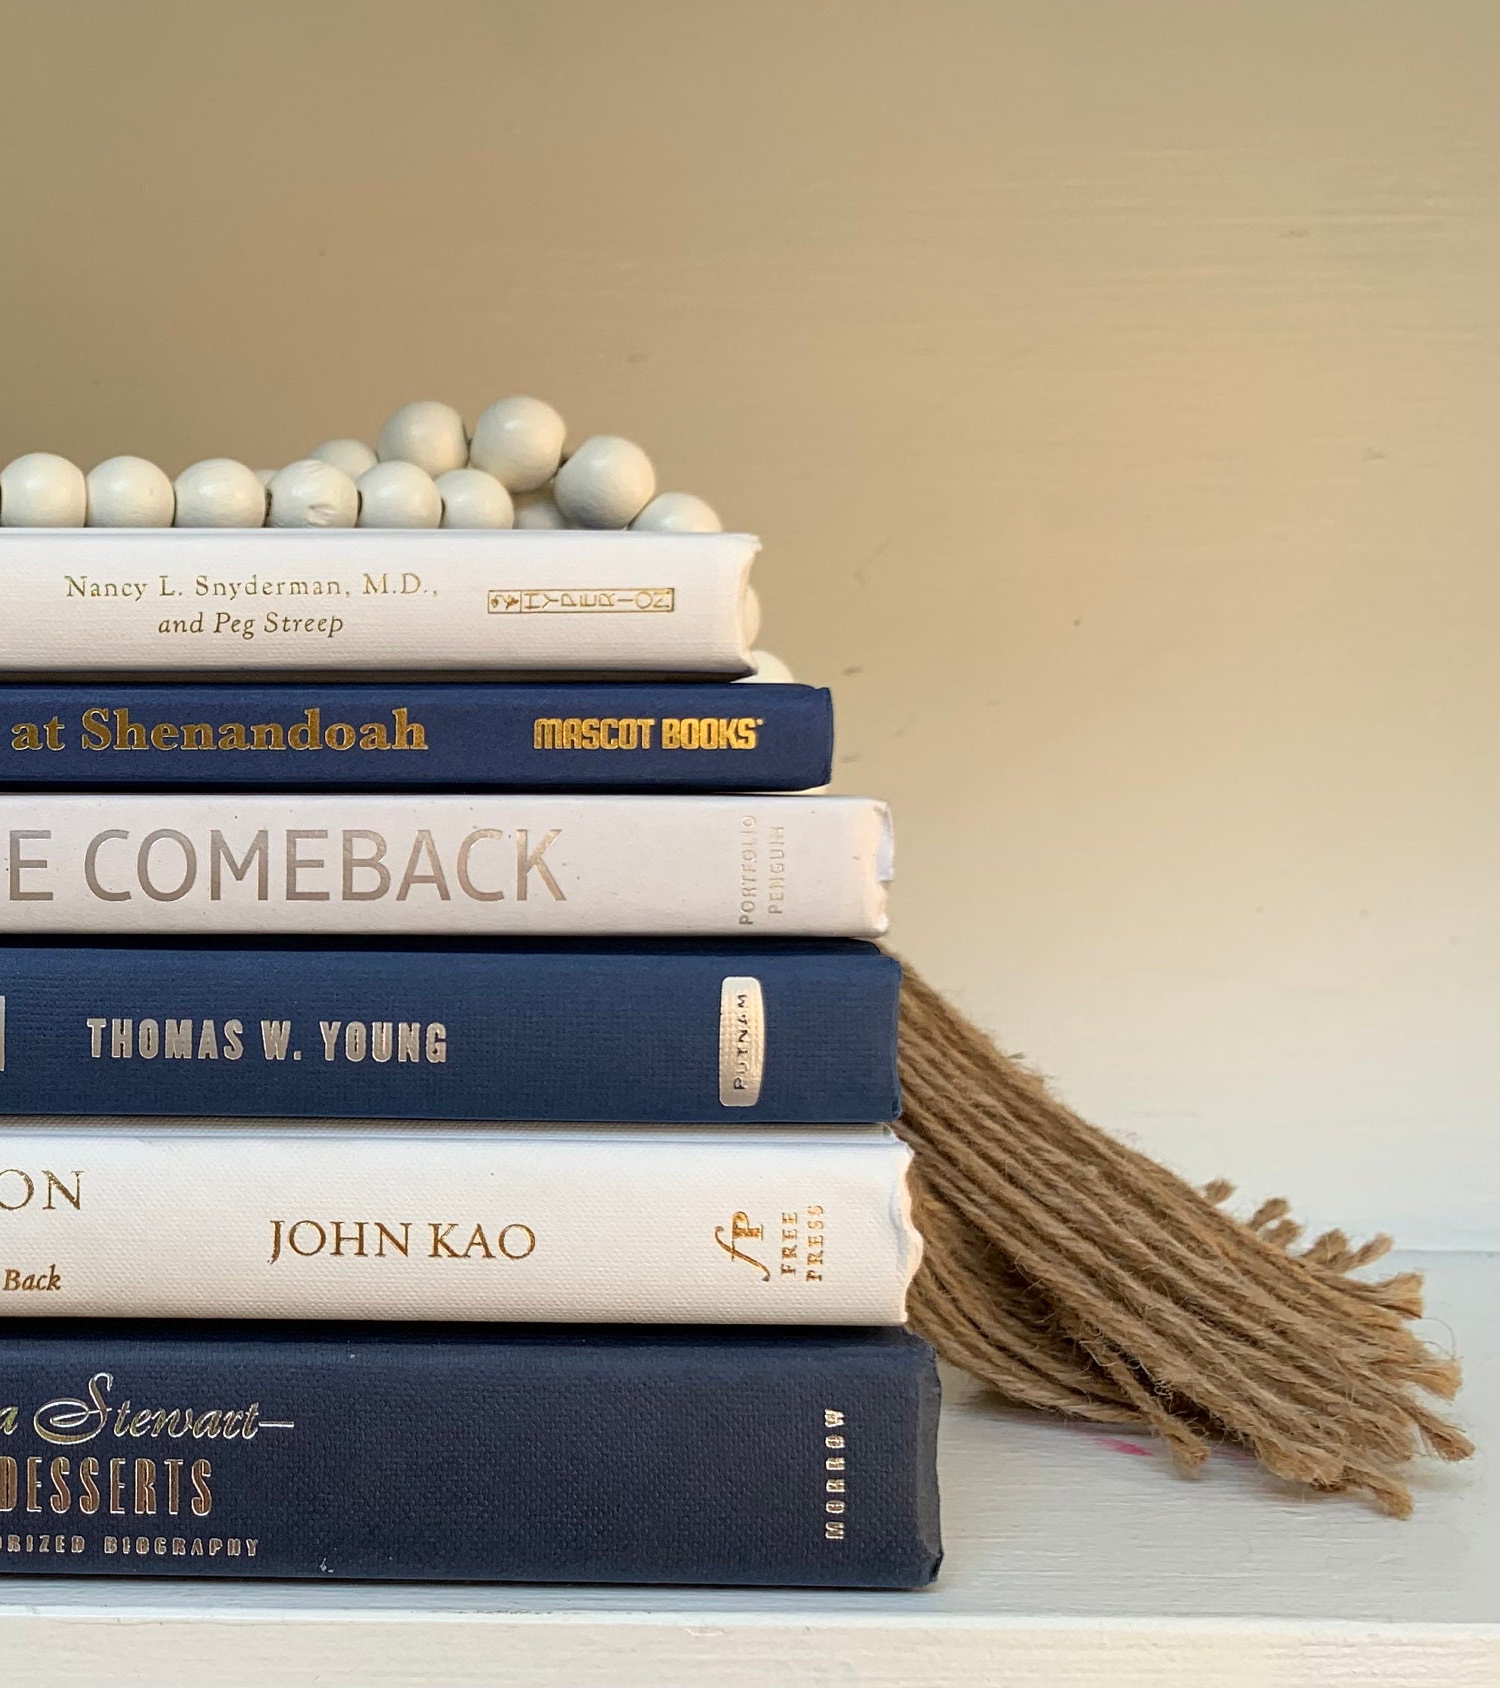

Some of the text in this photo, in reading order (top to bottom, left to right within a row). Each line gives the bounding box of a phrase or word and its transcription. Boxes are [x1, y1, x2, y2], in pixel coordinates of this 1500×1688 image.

[64, 572, 439, 601] Nancy L. Snyderman, M.D.,
[523, 591, 671, 610] HYPERION
[158, 611, 344, 639] and Peg Streep
[11, 714, 65, 752] at
[81, 708, 429, 752] Shenandoah
[533, 718, 655, 750] MASCOT
[85, 828, 569, 903] COMEBACK
[739, 815, 757, 925] PORTFOLIO
[767, 826, 785, 915] PENGUIN
[86, 1017, 449, 1064] THOMAS W. YOUNG
[733, 993, 749, 1090] PUTNAM
[269, 1219, 536, 1265] JOHN KAO
[781, 1212, 798, 1278] FREE
[805, 1205, 825, 1282] PRESS
[2, 1263, 61, 1292] Back
[824, 1408, 847, 1540] MORROW
[103, 1535, 261, 1558] BIOGRAPHY
